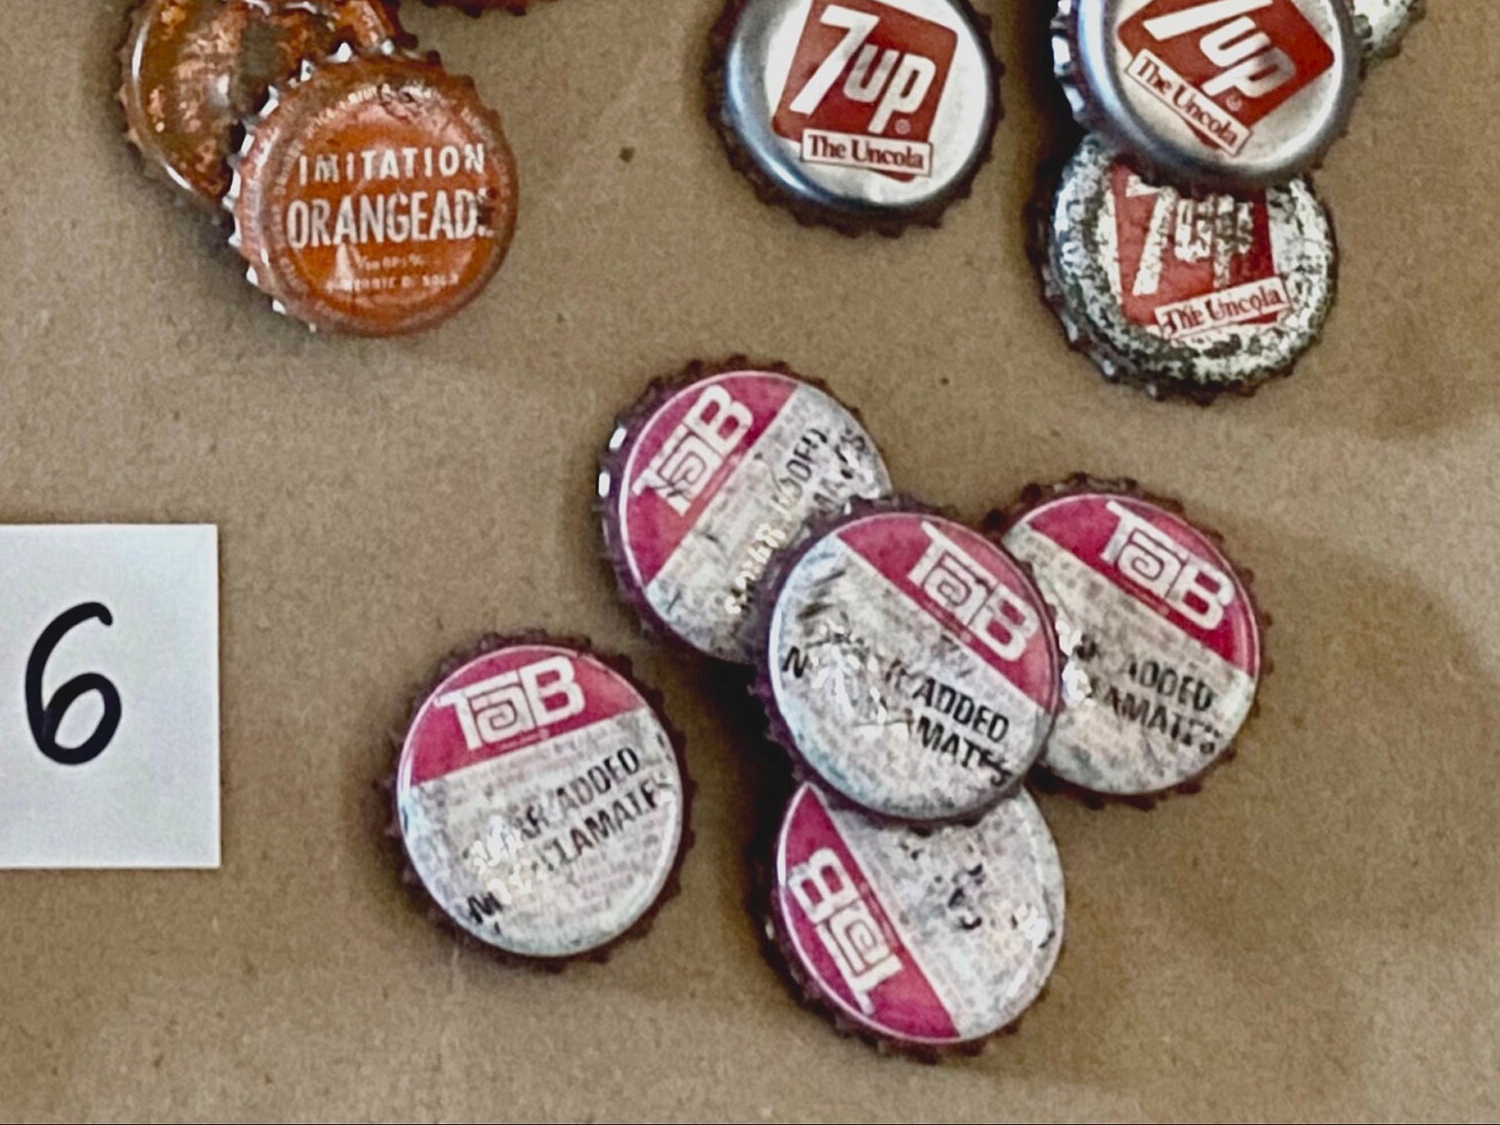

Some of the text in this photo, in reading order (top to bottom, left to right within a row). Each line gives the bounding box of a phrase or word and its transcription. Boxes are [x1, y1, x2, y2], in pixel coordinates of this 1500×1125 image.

[1136, 59, 1240, 149] The Uncola
[299, 143, 485, 187] IMITATION
[807, 136, 926, 171] The Uncola
[1205, 285, 1283, 320] Uncola
[25, 601, 122, 766] 6
[911, 677, 1011, 744] ADDED
[553, 746, 641, 809] ADDED
